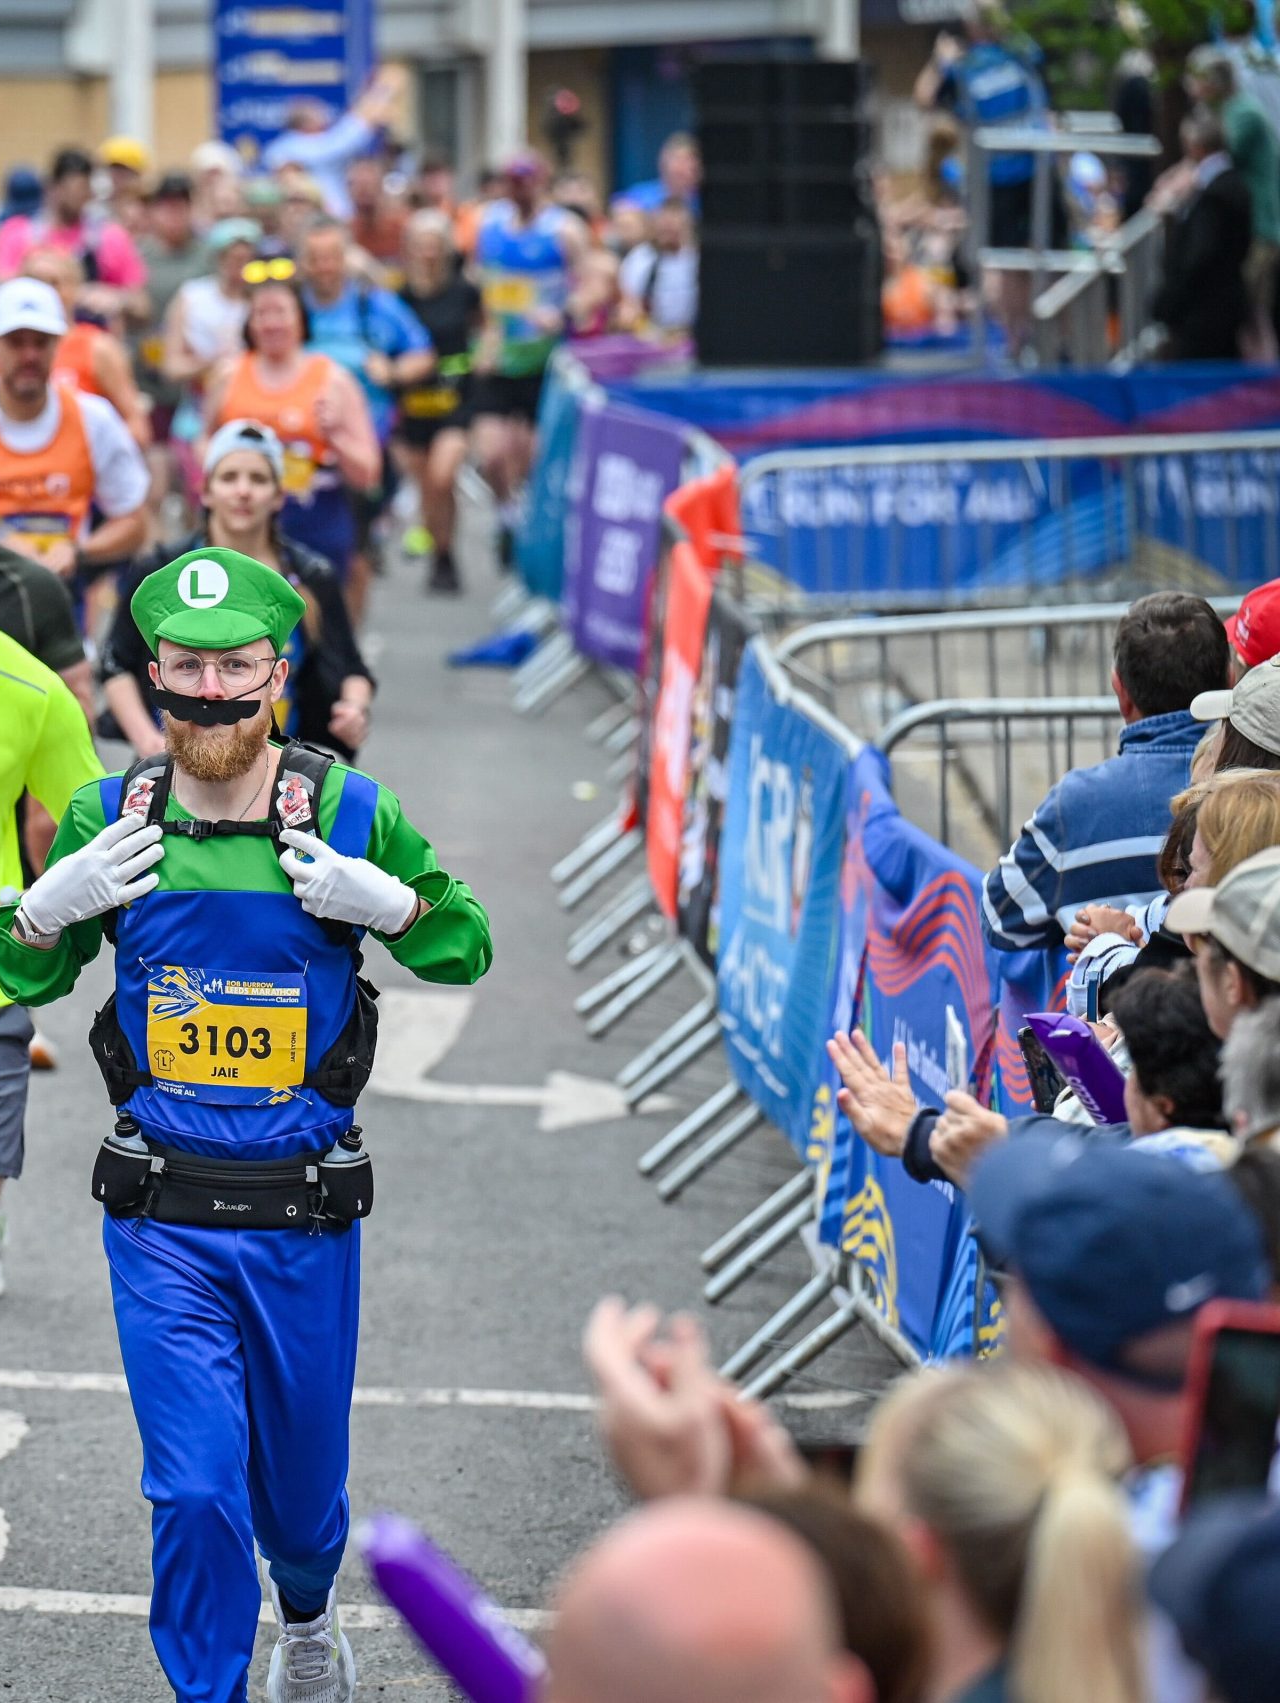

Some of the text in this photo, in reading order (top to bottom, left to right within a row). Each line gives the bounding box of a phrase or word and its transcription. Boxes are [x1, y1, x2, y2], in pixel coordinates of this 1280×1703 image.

[190, 570, 216, 599] L
[242, 981, 274, 989] BURROW
[225, 986, 300, 997] LEEDS MARATHON
[178, 1022, 272, 1060] 3103
[210, 1066, 239, 1079] JAIE
[170, 1087, 183, 1096] FOR
